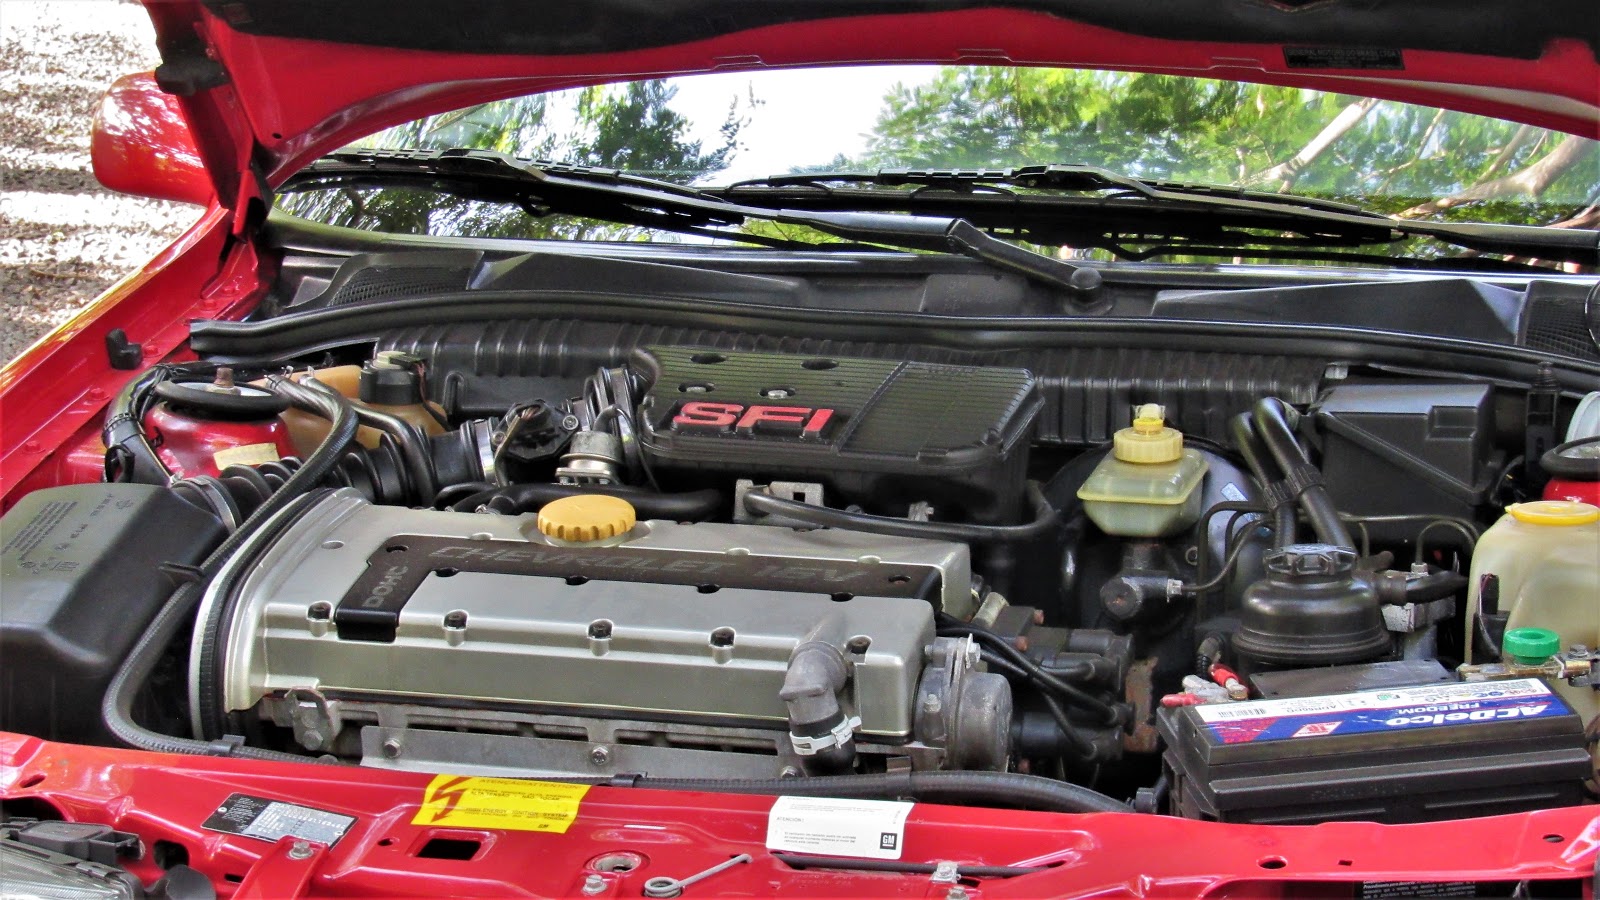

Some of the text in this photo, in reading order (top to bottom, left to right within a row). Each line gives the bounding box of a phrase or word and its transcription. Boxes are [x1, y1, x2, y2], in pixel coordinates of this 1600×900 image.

[672, 401, 834, 438] SFI
[428, 546, 869, 582] CHEVROLET 16V
[362, 565, 409, 608] DOHC
[1386, 703, 1550, 727] ACDelco
[1397, 702, 1481, 715] FREEDOM
[882, 834, 895, 845] GM
